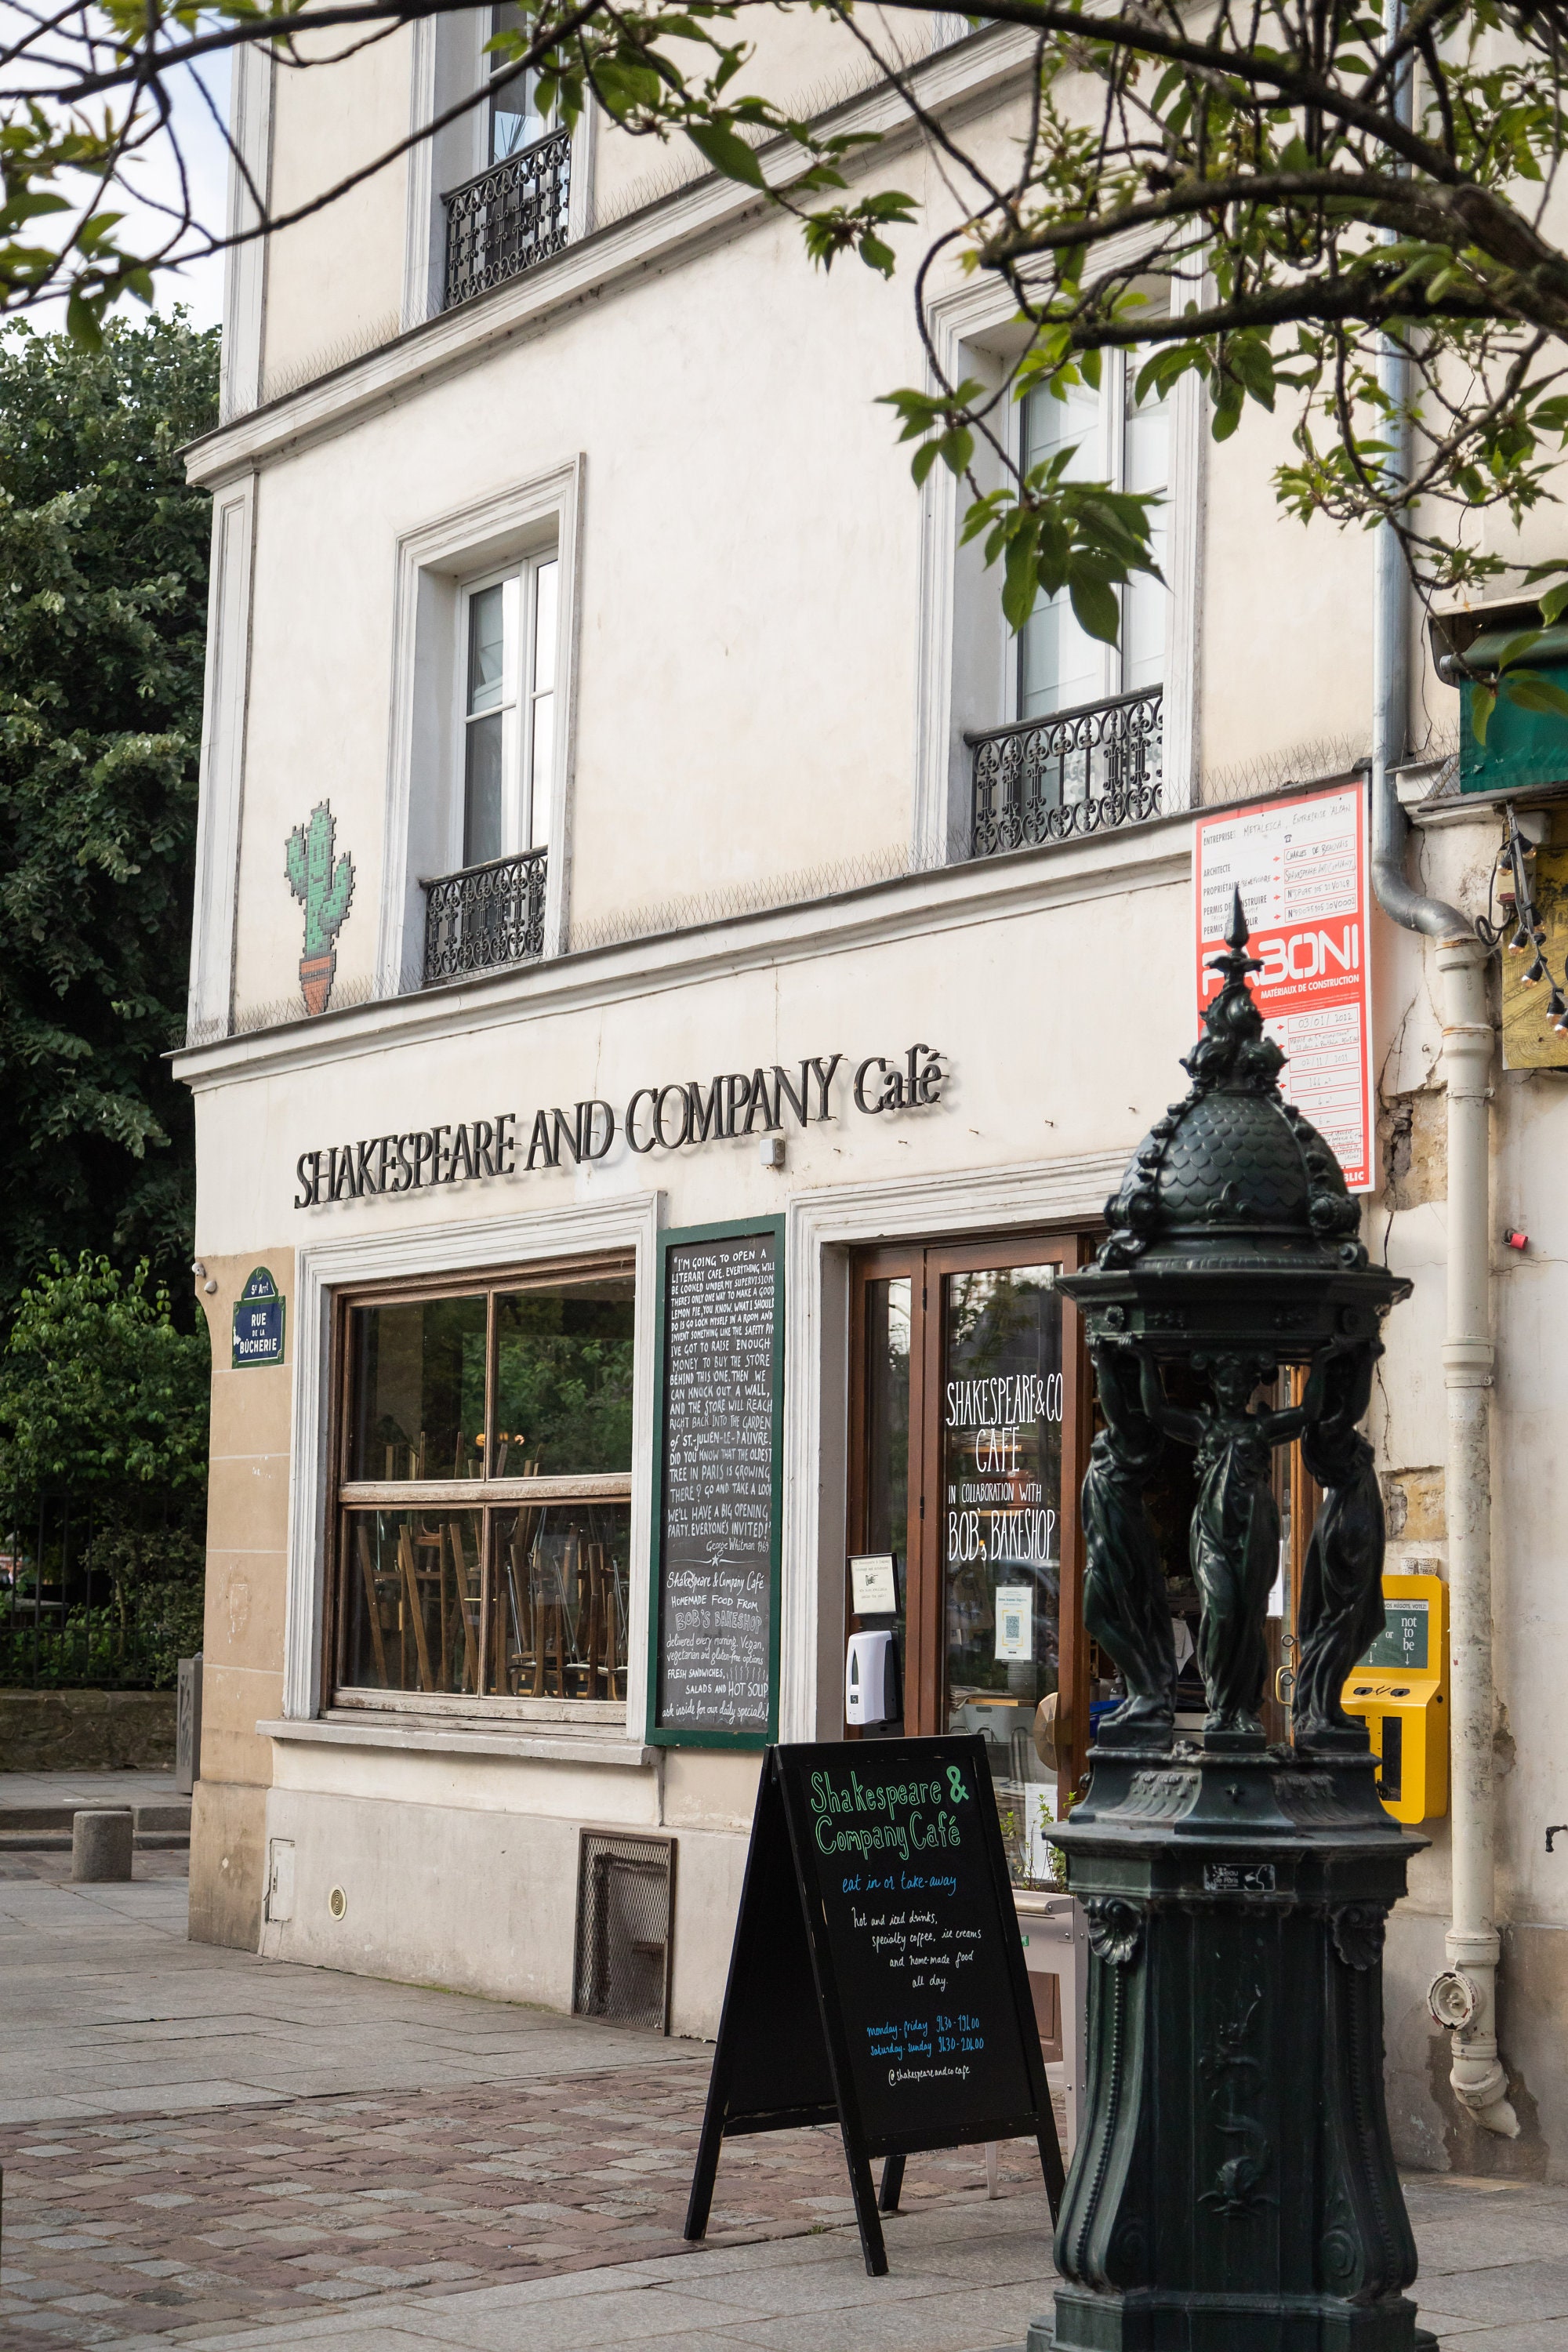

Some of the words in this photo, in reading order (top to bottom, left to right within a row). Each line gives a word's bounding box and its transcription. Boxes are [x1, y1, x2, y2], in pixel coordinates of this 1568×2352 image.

[1203, 864, 1230, 877] ARCHITECTE
[1203, 905, 1223, 916] PERMIS
[1203, 924, 1223, 935] PERMIS
[1261, 986, 1297, 999] MATÉRIAUX
[1298, 983, 1306, 993] DE
[1308, 975, 1359, 990] CONSTRUCTION
[294, 1112, 517, 1210] SHAKESPEARE
[524, 1099, 615, 1171] AND
[626, 1054, 844, 1154] COMPANY
[853, 1043, 942, 1116] Café
[1344, 1171, 1363, 1182] BLIC
[692, 1255, 717, 1271] GOING
[720, 1254, 729, 1262] TO
[733, 1250, 756, 1261] OPEN
[760, 1248, 767, 1258] A
[671, 1271, 705, 1284] LITERARY
[726, 1264, 760, 1277] EVERYTHING
[761, 1261, 775, 1272] WILL
[252, 1313, 267, 1327] RUE
[670, 1345, 682, 1358] I'VE
[684, 1342, 698, 1356] GOT
[700, 1341, 709, 1352] TO
[711, 1340, 729, 1352] RAISE
[736, 1338, 771, 1351] ENOUGH
[672, 1357, 698, 1373] MONEY
[702, 1356, 710, 1367] TO
[714, 1355, 728, 1367] BUY
[731, 1355, 741, 1367] THE
[745, 1353, 770, 1368] STORE
[670, 1372, 694, 1386] BEHIND
[696, 1370, 710, 1383] THIS
[731, 1370, 749, 1382] THEN
[754, 1370, 766, 1382] WE
[670, 1388, 685, 1401] CAN
[688, 1386, 713, 1399] KNOCK
[716, 1385, 731, 1397] OUT
[735, 1385, 741, 1396] A
[670, 1402, 685, 1416] AND
[688, 1401, 701, 1414] THE
[705, 1399, 726, 1417] STORE
[728, 1399, 744, 1412] WILL
[746, 1398, 773, 1414] REACH
[669, 1467, 687, 1483] TREE
[690, 1466, 699, 1481] IN
[701, 1464, 724, 1481] PARIS
[726, 1465, 732, 1476] IS
[735, 1465, 770, 1483] GROWING
[948, 1485, 956, 1504] IN
[962, 1483, 1014, 1502] COLLABORATION
[1019, 1483, 1042, 1502] WITH
[691, 1520, 729, 1537] EVERYONE'S
[991, 1508, 1055, 1560] BAKESHOP
[706, 1540, 728, 1557] George
[728, 1537, 755, 1551] Whitman
[667, 1570, 710, 1592] Shakespeare
[713, 1572, 718, 1586] &
[720, 1571, 745, 1595] Company
[747, 1571, 764, 1594] Café
[671, 1595, 706, 1608] HOMEMADE
[712, 1595, 732, 1606] FOOD
[737, 1599, 759, 1611] FROM
[715, 1611, 762, 1634] BAKESHOP
[1401, 1617, 1417, 1627] not
[667, 1634, 694, 1648] delivered
[696, 1637, 712, 1650] every
[1404, 1628, 1414, 1638] to
[1403, 1638, 1414, 1650] be
[667, 1650, 699, 1665] vegetarian
[701, 1650, 710, 1659] and
[743, 1654, 764, 1668] options
[668, 1669, 686, 1679] FRESH
[685, 1684, 711, 1694] SALADS
[728, 1681, 746, 1697] HOT
[748, 1682, 768, 1697] SOUP
[662, 1704, 673, 1717] ask
[677, 1699, 695, 1715] inside
[696, 1700, 706, 1719] for
[720, 1700, 735, 1724] daily
[811, 1770, 942, 1820] Shakespeare
[946, 1765, 969, 1804] &
[815, 1814, 909, 1860] Company
[909, 1810, 960, 1850] Café
[843, 1875, 861, 1892] eat
[866, 1875, 880, 1891] in
[884, 1875, 895, 1890] or
[851, 1907, 867, 1927] hot
[871, 1913, 885, 1926] and
[890, 1910, 905, 1926] iced
[872, 1931, 906, 1952] specialty
[942, 1927, 953, 1939] ice
[956, 1929, 982, 1939] creams
[890, 1953, 905, 1967] and
[955, 1951, 973, 1968] food
[913, 1976, 924, 1989] all
